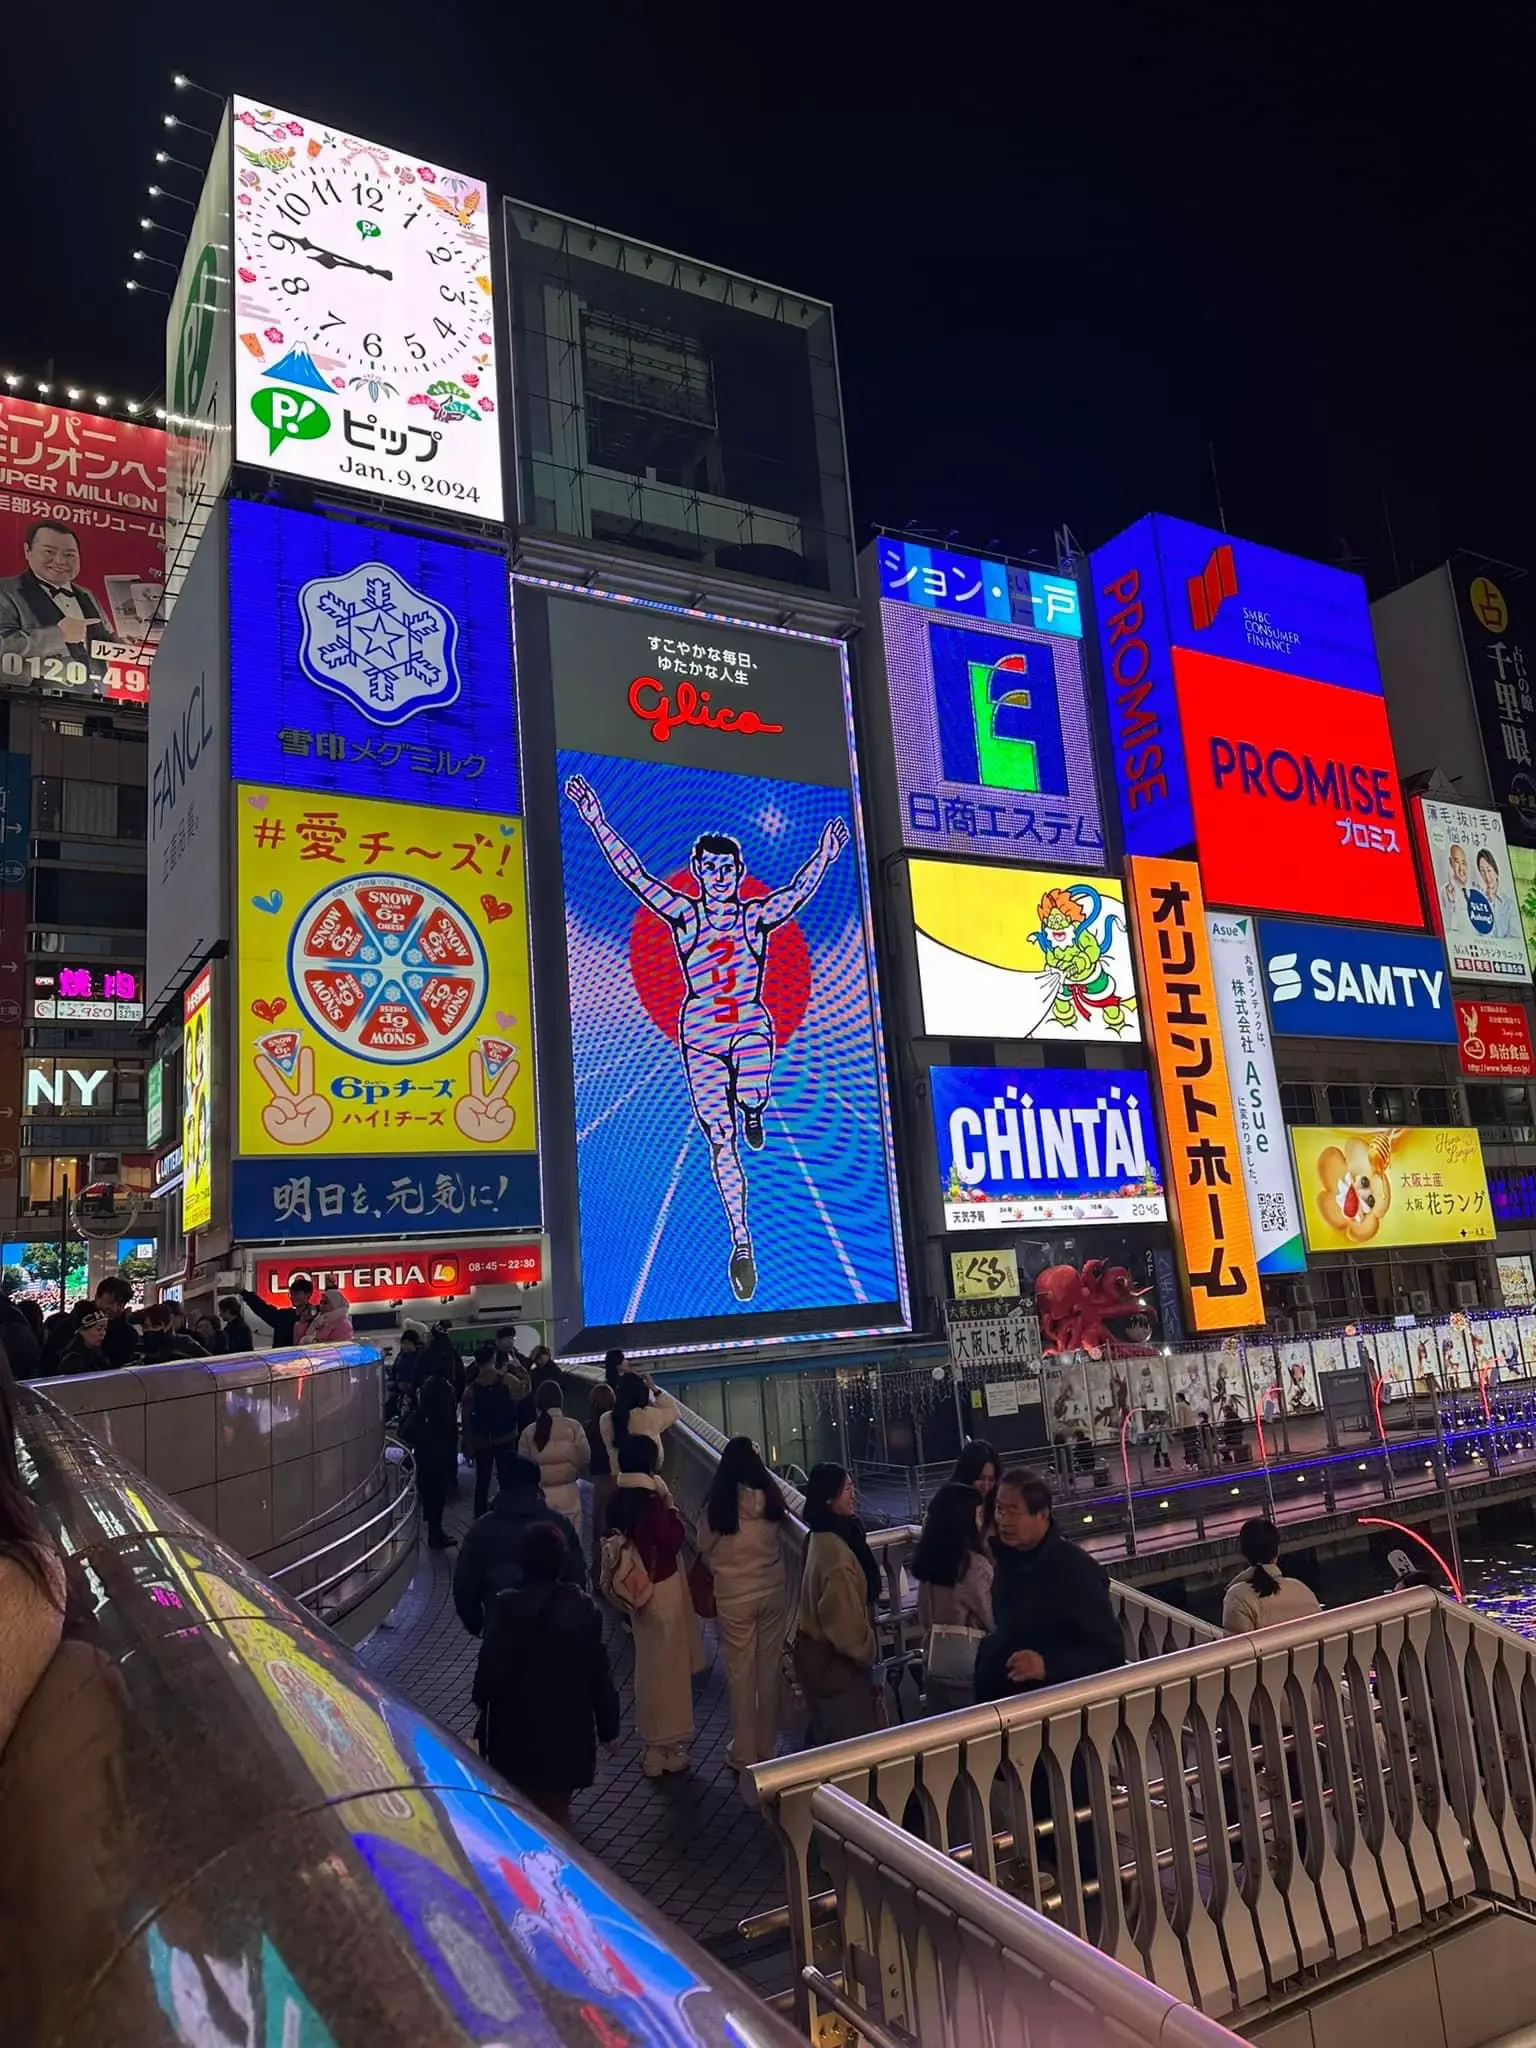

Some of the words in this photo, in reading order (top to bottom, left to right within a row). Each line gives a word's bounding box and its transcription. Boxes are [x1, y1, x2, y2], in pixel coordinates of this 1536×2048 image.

[276, 193, 311, 227] 10
[312, 180, 343, 206] 11
[352, 182, 385, 212] 12
[403, 211, 419, 230] 1
[267, 230, 297, 254] 9
[427, 247, 454, 266] 2
[281, 276, 310, 297] 8
[439, 285, 466, 306] 3
[320, 311, 347, 332] 7
[433, 315, 458, 340] 4
[363, 333, 383, 358] 6
[404, 333, 427, 360] 5
[343, 408, 443, 463] ピップ
[0, 435, 166, 493] リオンヘ
[66, 481, 158, 514] MILLION
[1243, 607, 1271, 624] SMBC
[1244, 620, 1301, 646] CONSUMER
[1247, 632, 1292, 655] FINANCE
[648, 635, 759, 669] すこやかな毎日、
[657, 654, 749, 686] ゆたかな人生
[1104, 567, 1168, 811] PROMISE
[1486, 641, 1532, 767] 千里眼
[628, 675, 784, 742] Glico
[153, 670, 213, 842] FANCL
[277, 726, 486, 779] 雪印メグミルク
[1209, 736, 1395, 820] PROMISE
[909, 791, 1104, 849] 日商エステム
[1336, 817, 1401, 853] プロミス
[368, 891, 413, 907] SNOW
[312, 906, 343, 949] SNOW
[438, 917, 469, 958] SNOW
[1212, 922, 1239, 938] Asue
[706, 936, 740, 1024] グリコ
[1310, 958, 1443, 1010] SAMTY
[310, 978, 345, 1023] SNOW
[441, 985, 469, 1028] SNOW
[370, 1032, 416, 1046] SNOW
[27, 1069, 108, 1106] NY
[1150, 881, 1248, 1298] オリエントホーム
[1401, 1172, 1444, 1189] 大阪土産
[965, 1256, 1007, 1292] くくる
[956, 1323, 1029, 1360] 大阪に乾杯
